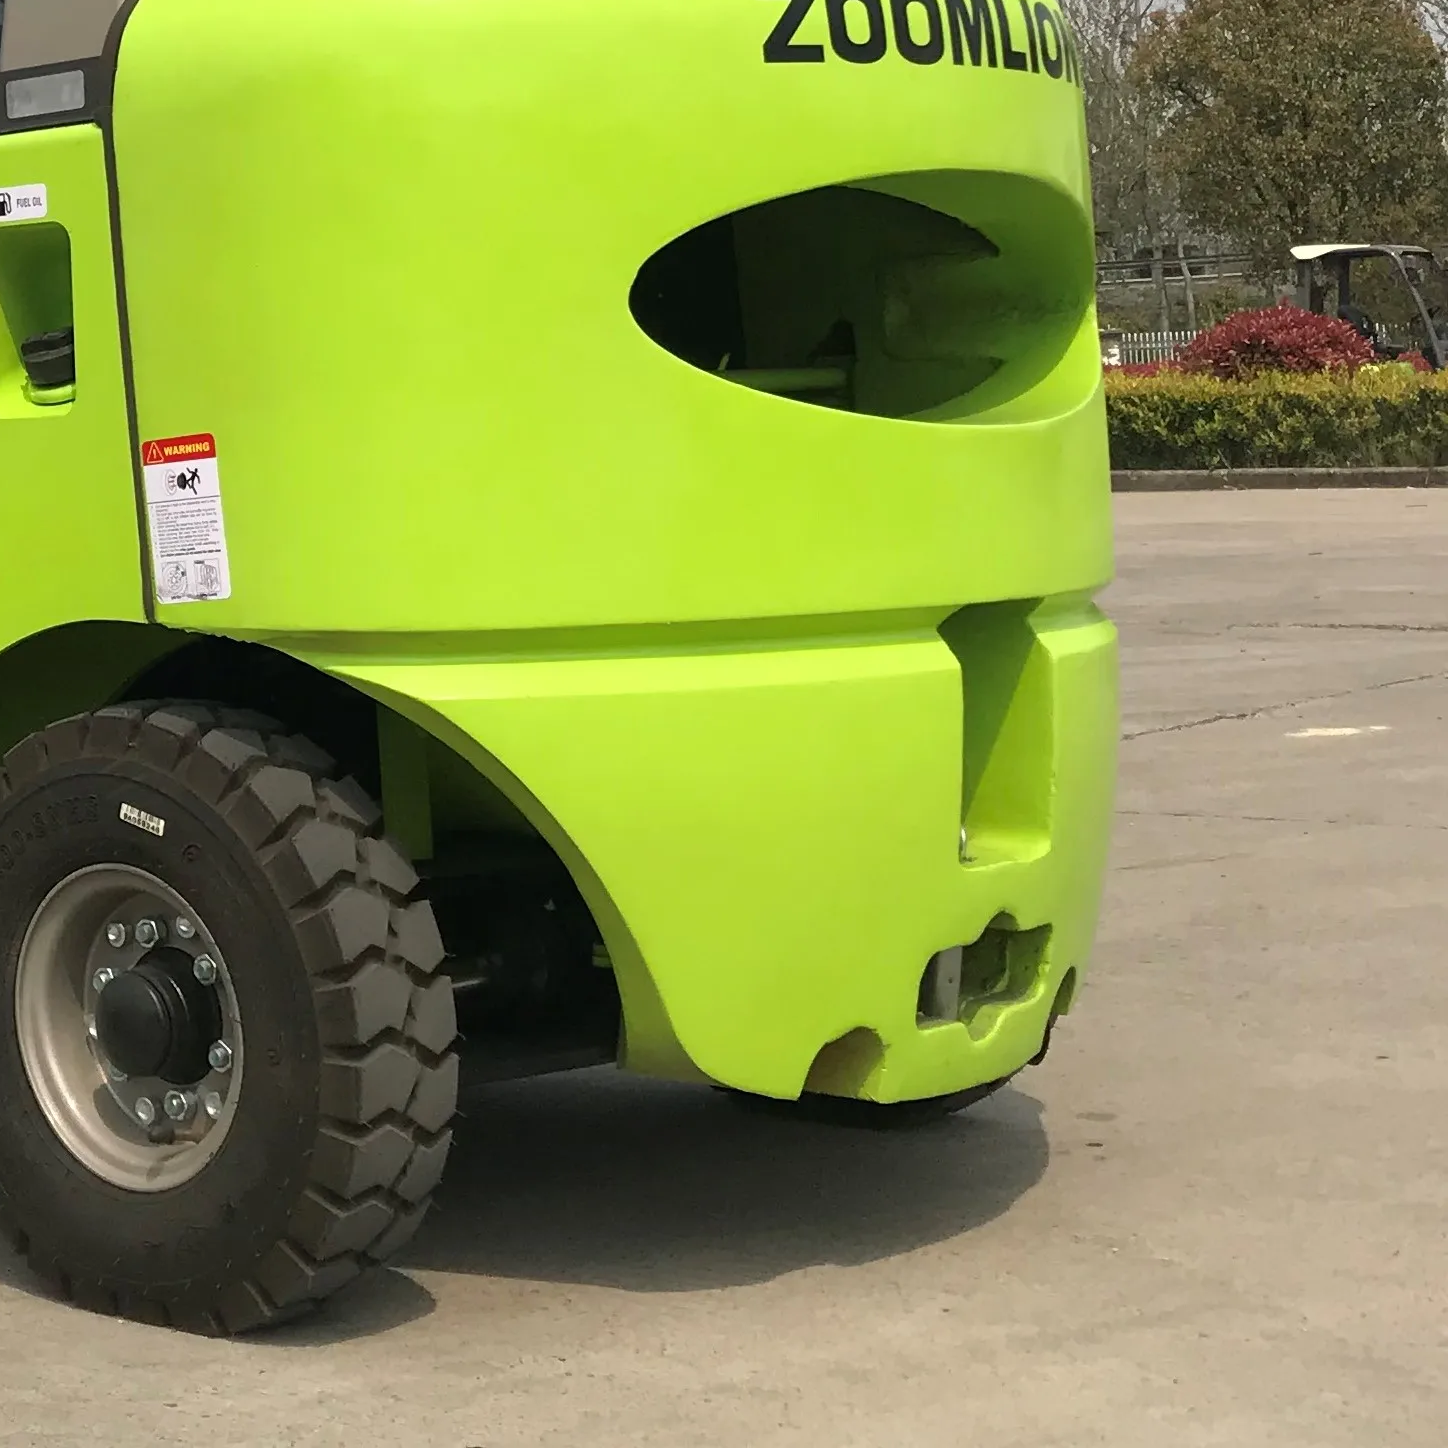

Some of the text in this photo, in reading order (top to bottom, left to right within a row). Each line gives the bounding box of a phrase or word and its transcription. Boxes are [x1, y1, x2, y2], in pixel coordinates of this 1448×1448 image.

[16, 196, 42, 208] FUEL OIL
[163, 441, 211, 457] WARNING
